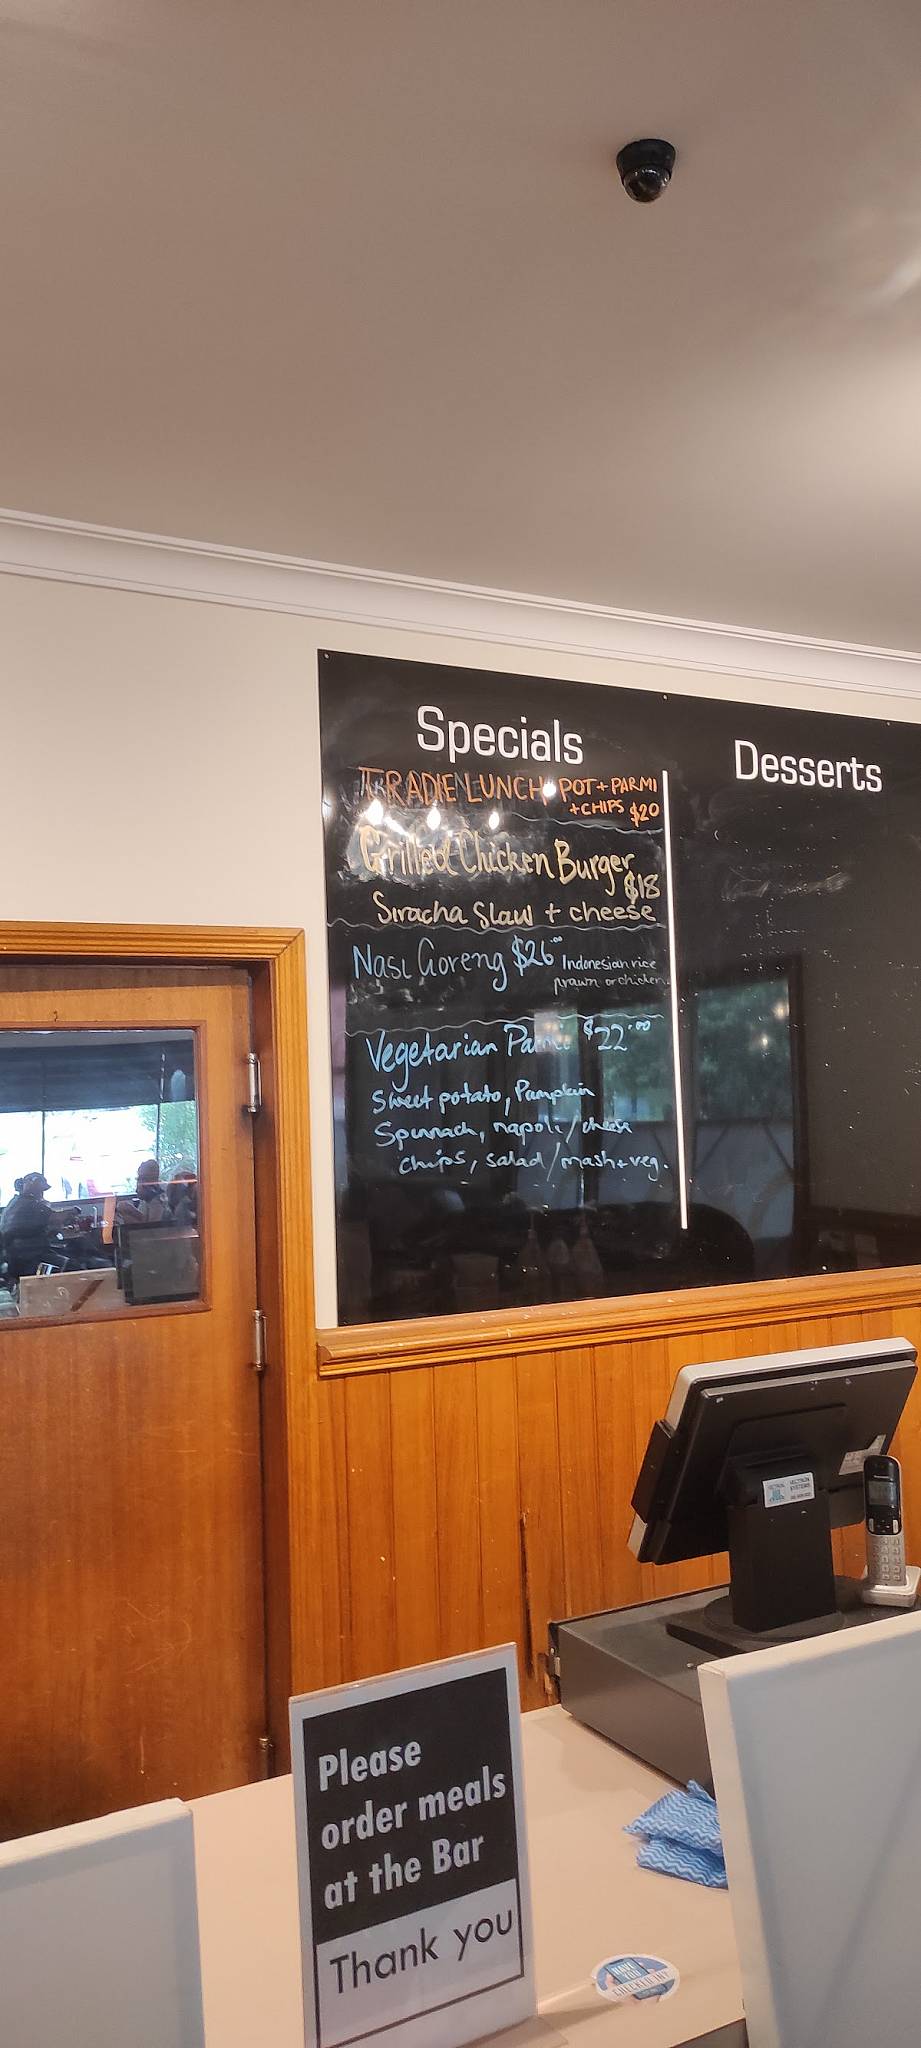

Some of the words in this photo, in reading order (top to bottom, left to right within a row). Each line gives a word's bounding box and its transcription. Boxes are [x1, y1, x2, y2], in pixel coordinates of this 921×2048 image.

[418, 705, 584, 765] Specials
[464, 772, 548, 806] LUNCH
[735, 739, 882, 792] Desserts
[629, 802, 660, 827] $20
[457, 828, 556, 879] Chicken
[554, 838, 635, 897] Burger
[624, 870, 661, 904] $18
[569, 901, 656, 922] cheese
[353, 944, 412, 980] Nasi
[418, 937, 508, 992] Goreng
[554, 976, 600, 995] prawn
[366, 1030, 498, 1093] Vegetarian
[319, 1741, 422, 1792] Please
[321, 1800, 408, 1850] order
[418, 1765, 506, 1821] meals
[324, 1871, 358, 1910] at
[369, 1853, 422, 1894] the
[432, 1836, 485, 1875] Bar
[330, 1927, 439, 1993] Thank
[453, 1910, 513, 1962] you
